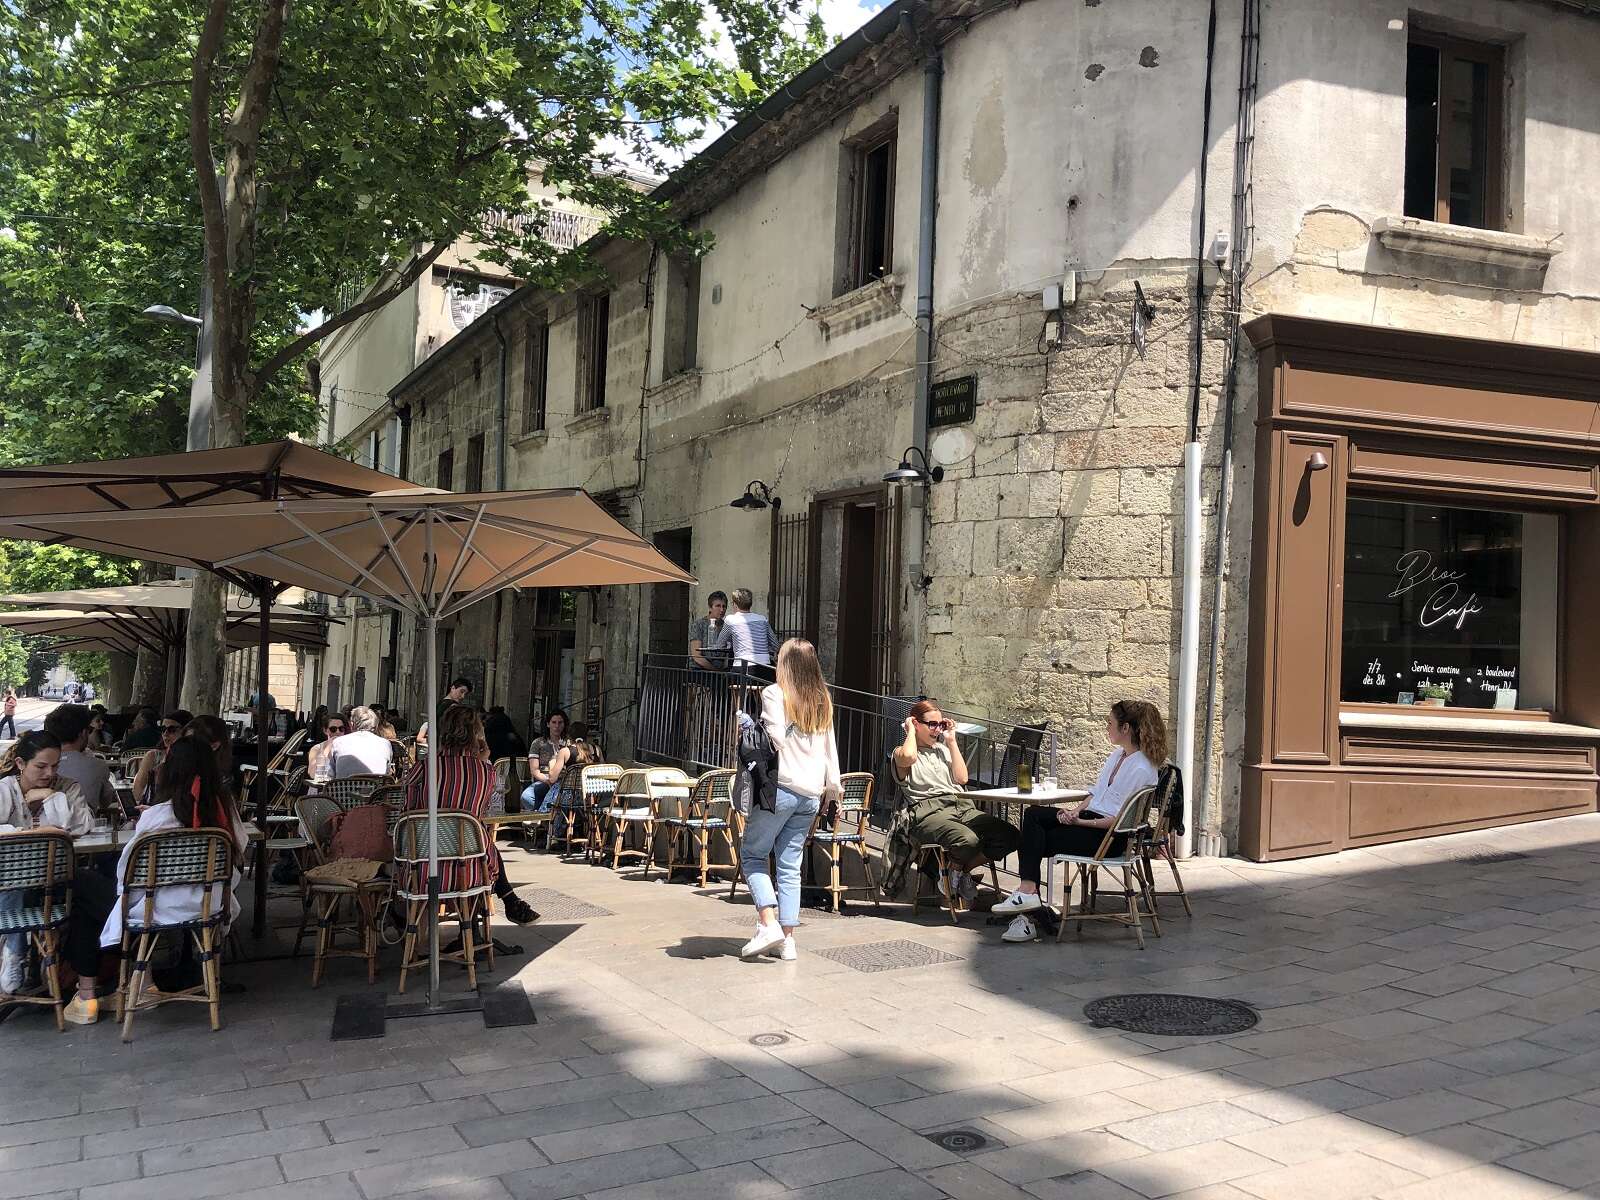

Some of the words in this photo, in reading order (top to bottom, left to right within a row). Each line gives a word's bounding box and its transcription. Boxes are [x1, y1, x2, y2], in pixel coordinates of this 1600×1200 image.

[935, 403, 956, 418] HENRI
[959, 401, 967, 414] IV
[1387, 549, 1468, 598] Broc
[1420, 582, 1484, 630] Café
[1367, 657, 1381, 674] 7/7
[1411, 660, 1435, 673] Service
[1436, 665, 1460, 675] continu
[1476, 668, 1483, 676] 2
[1485, 664, 1516, 678] boulevard
[1362, 673, 1374, 685] dès
[1375, 673, 1386, 686] 8h
[1416, 676, 1430, 688] 12h
[1479, 679, 1501, 692] Henri
